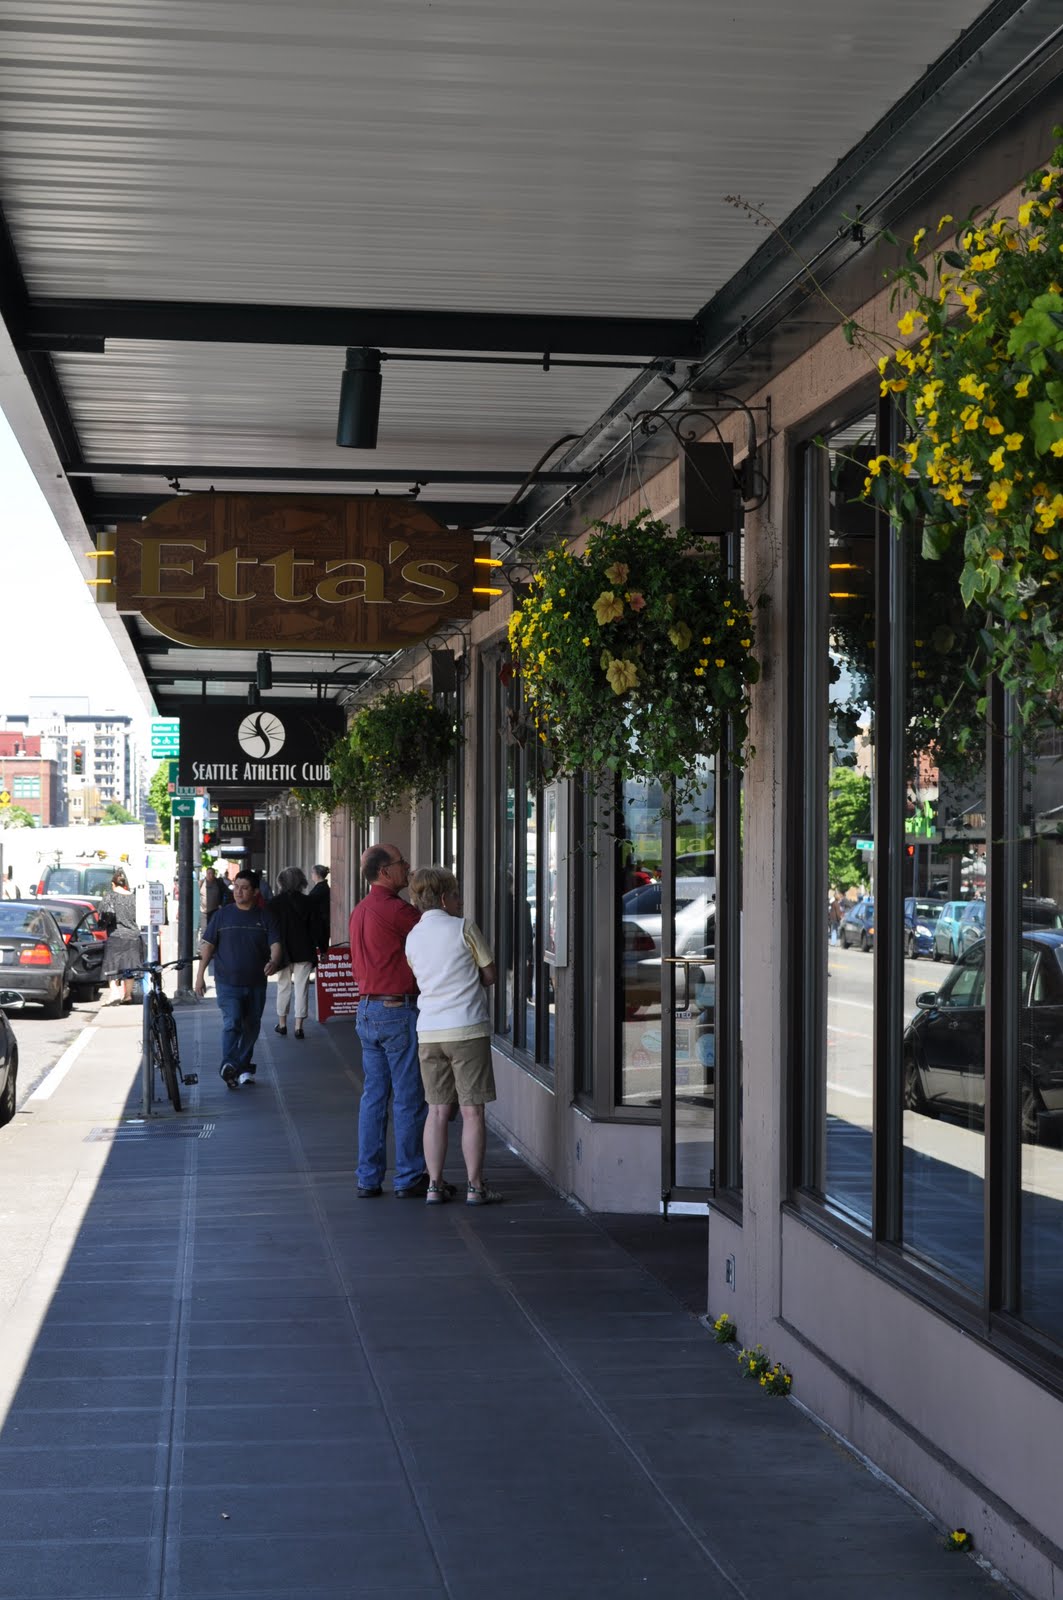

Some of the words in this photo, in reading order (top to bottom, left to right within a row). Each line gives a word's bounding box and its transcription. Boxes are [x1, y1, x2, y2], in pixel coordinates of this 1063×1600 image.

[131, 538, 460, 606] Etta's
[192, 761, 239, 781] SEATTLE
[243, 762, 297, 781] ATHLETIC
[302, 762, 331, 781] CLUB
